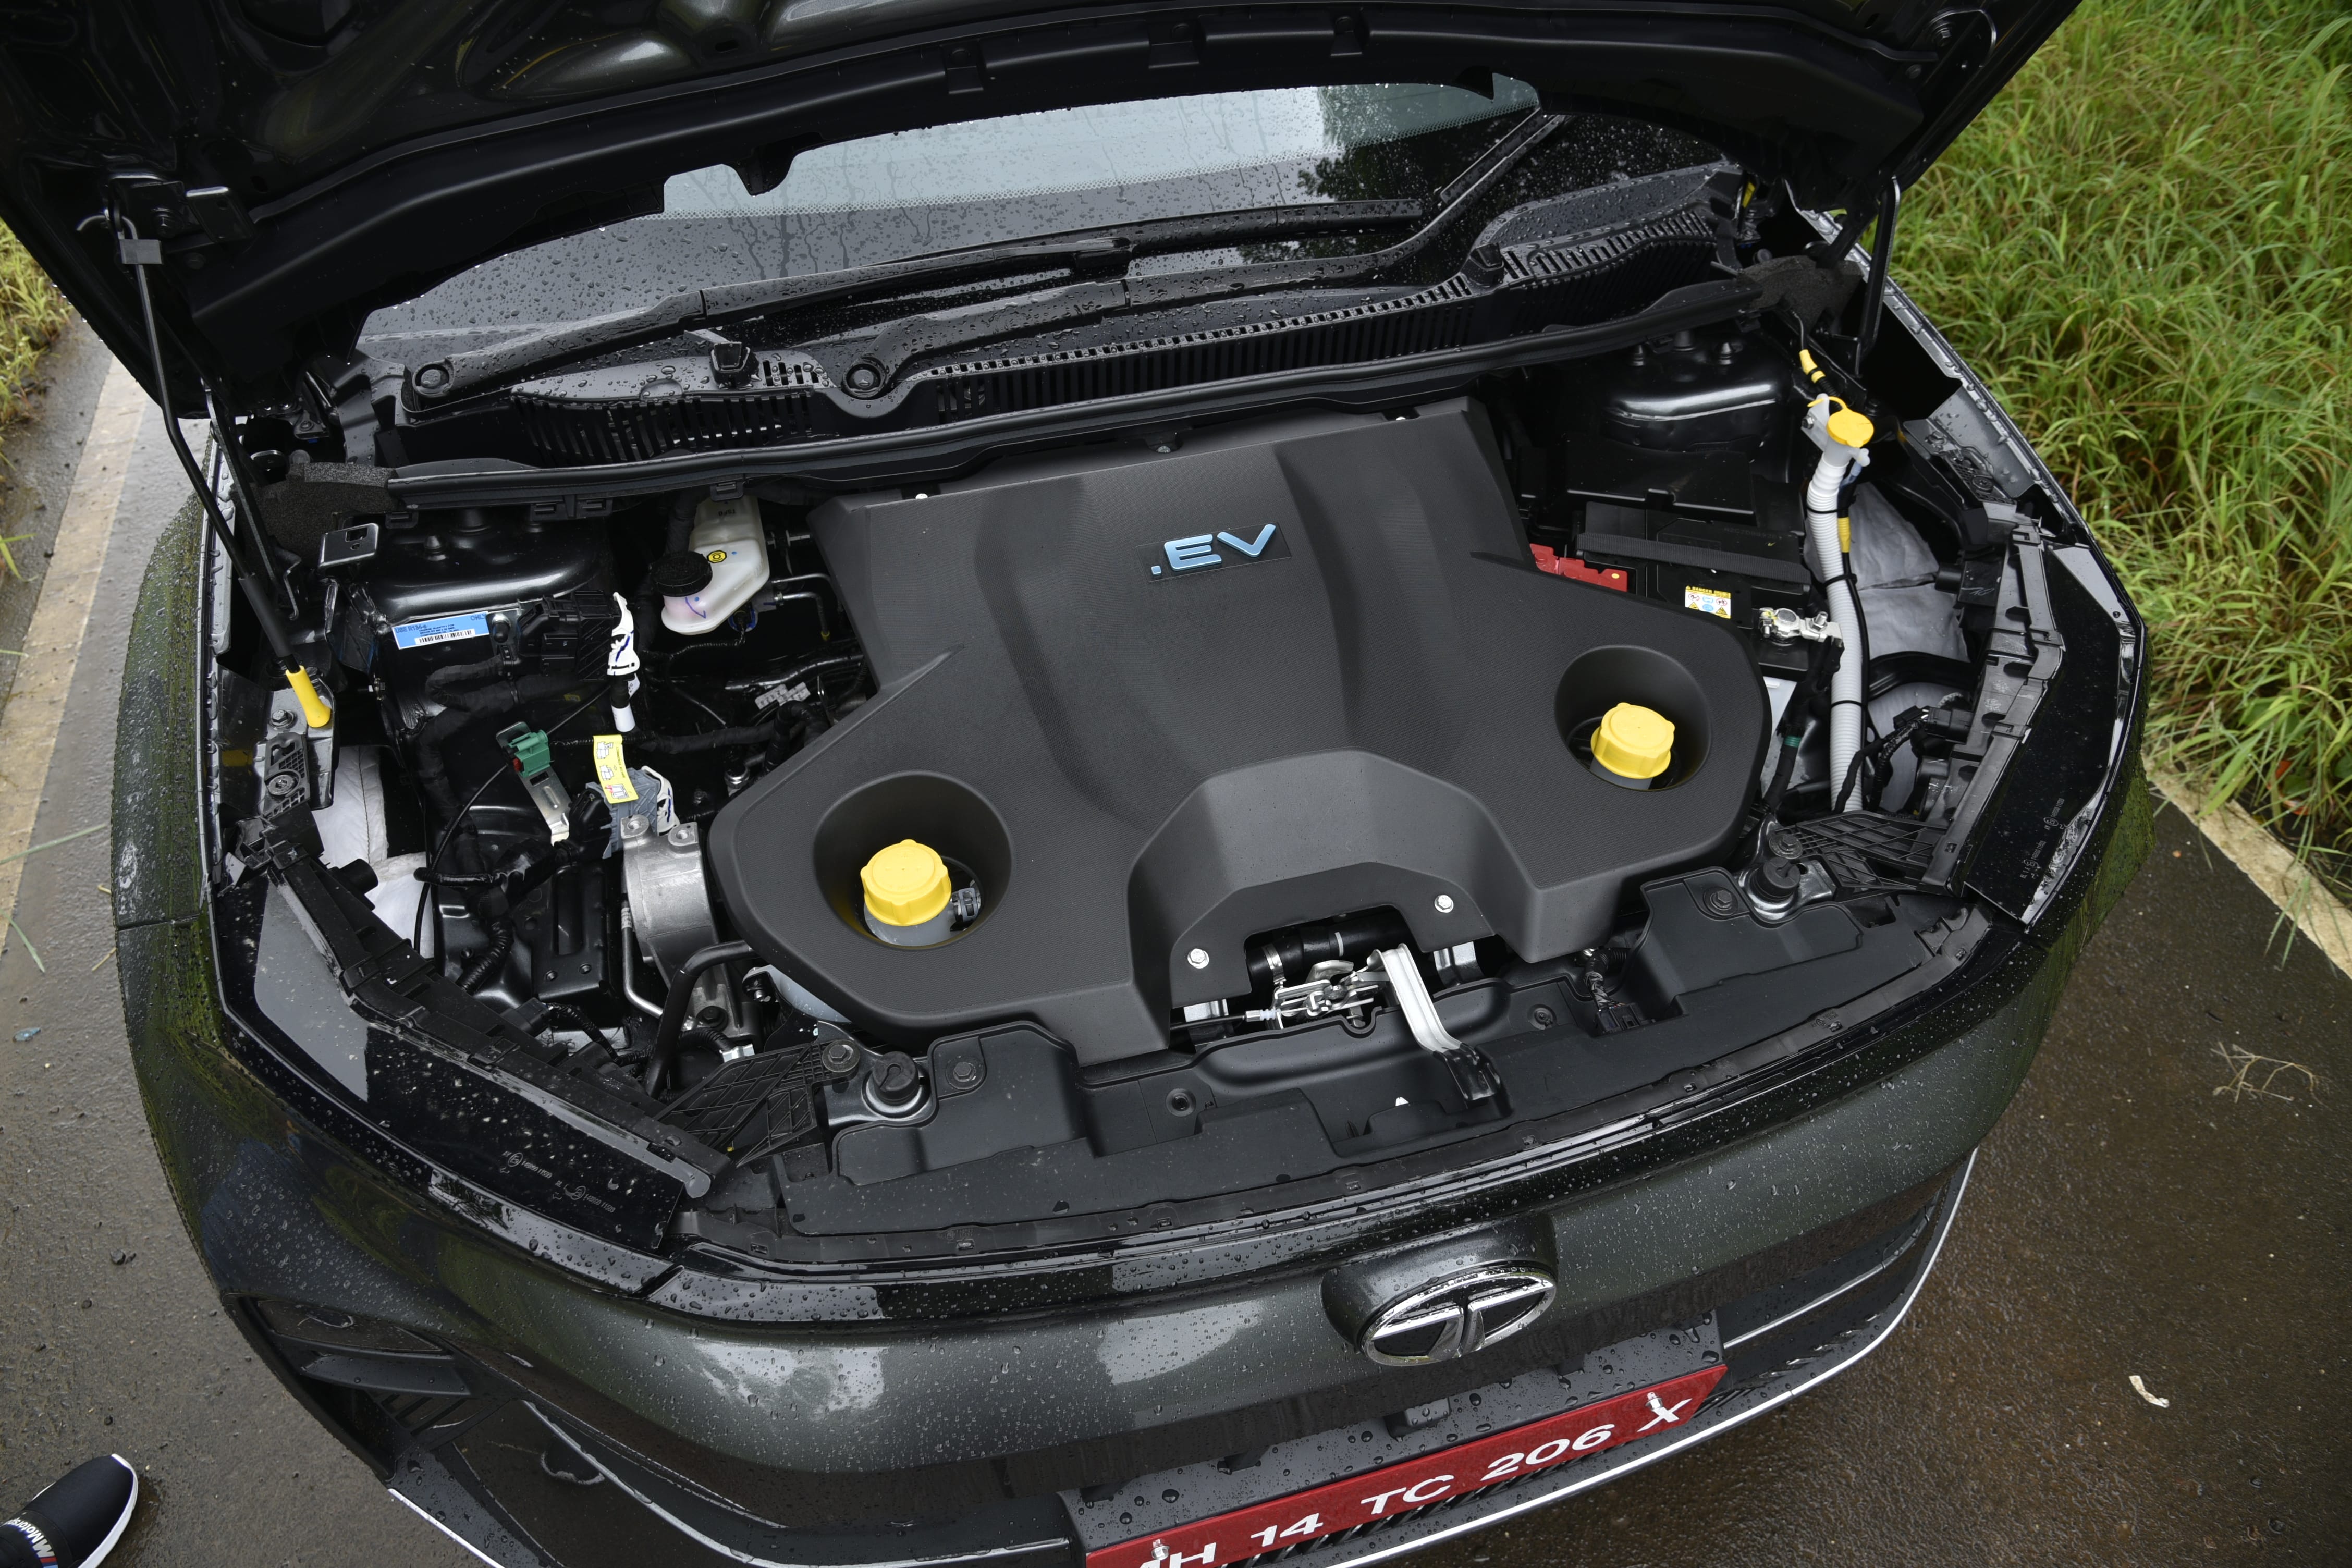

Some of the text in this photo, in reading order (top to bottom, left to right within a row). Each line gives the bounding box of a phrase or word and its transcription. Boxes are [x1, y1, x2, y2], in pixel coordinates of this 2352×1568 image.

[1251, 1513, 1324, 1547] 14
[1361, 1475, 1454, 1514] TC
[1480, 1424, 1615, 1481] 206
[1636, 1398, 1693, 1432] X
